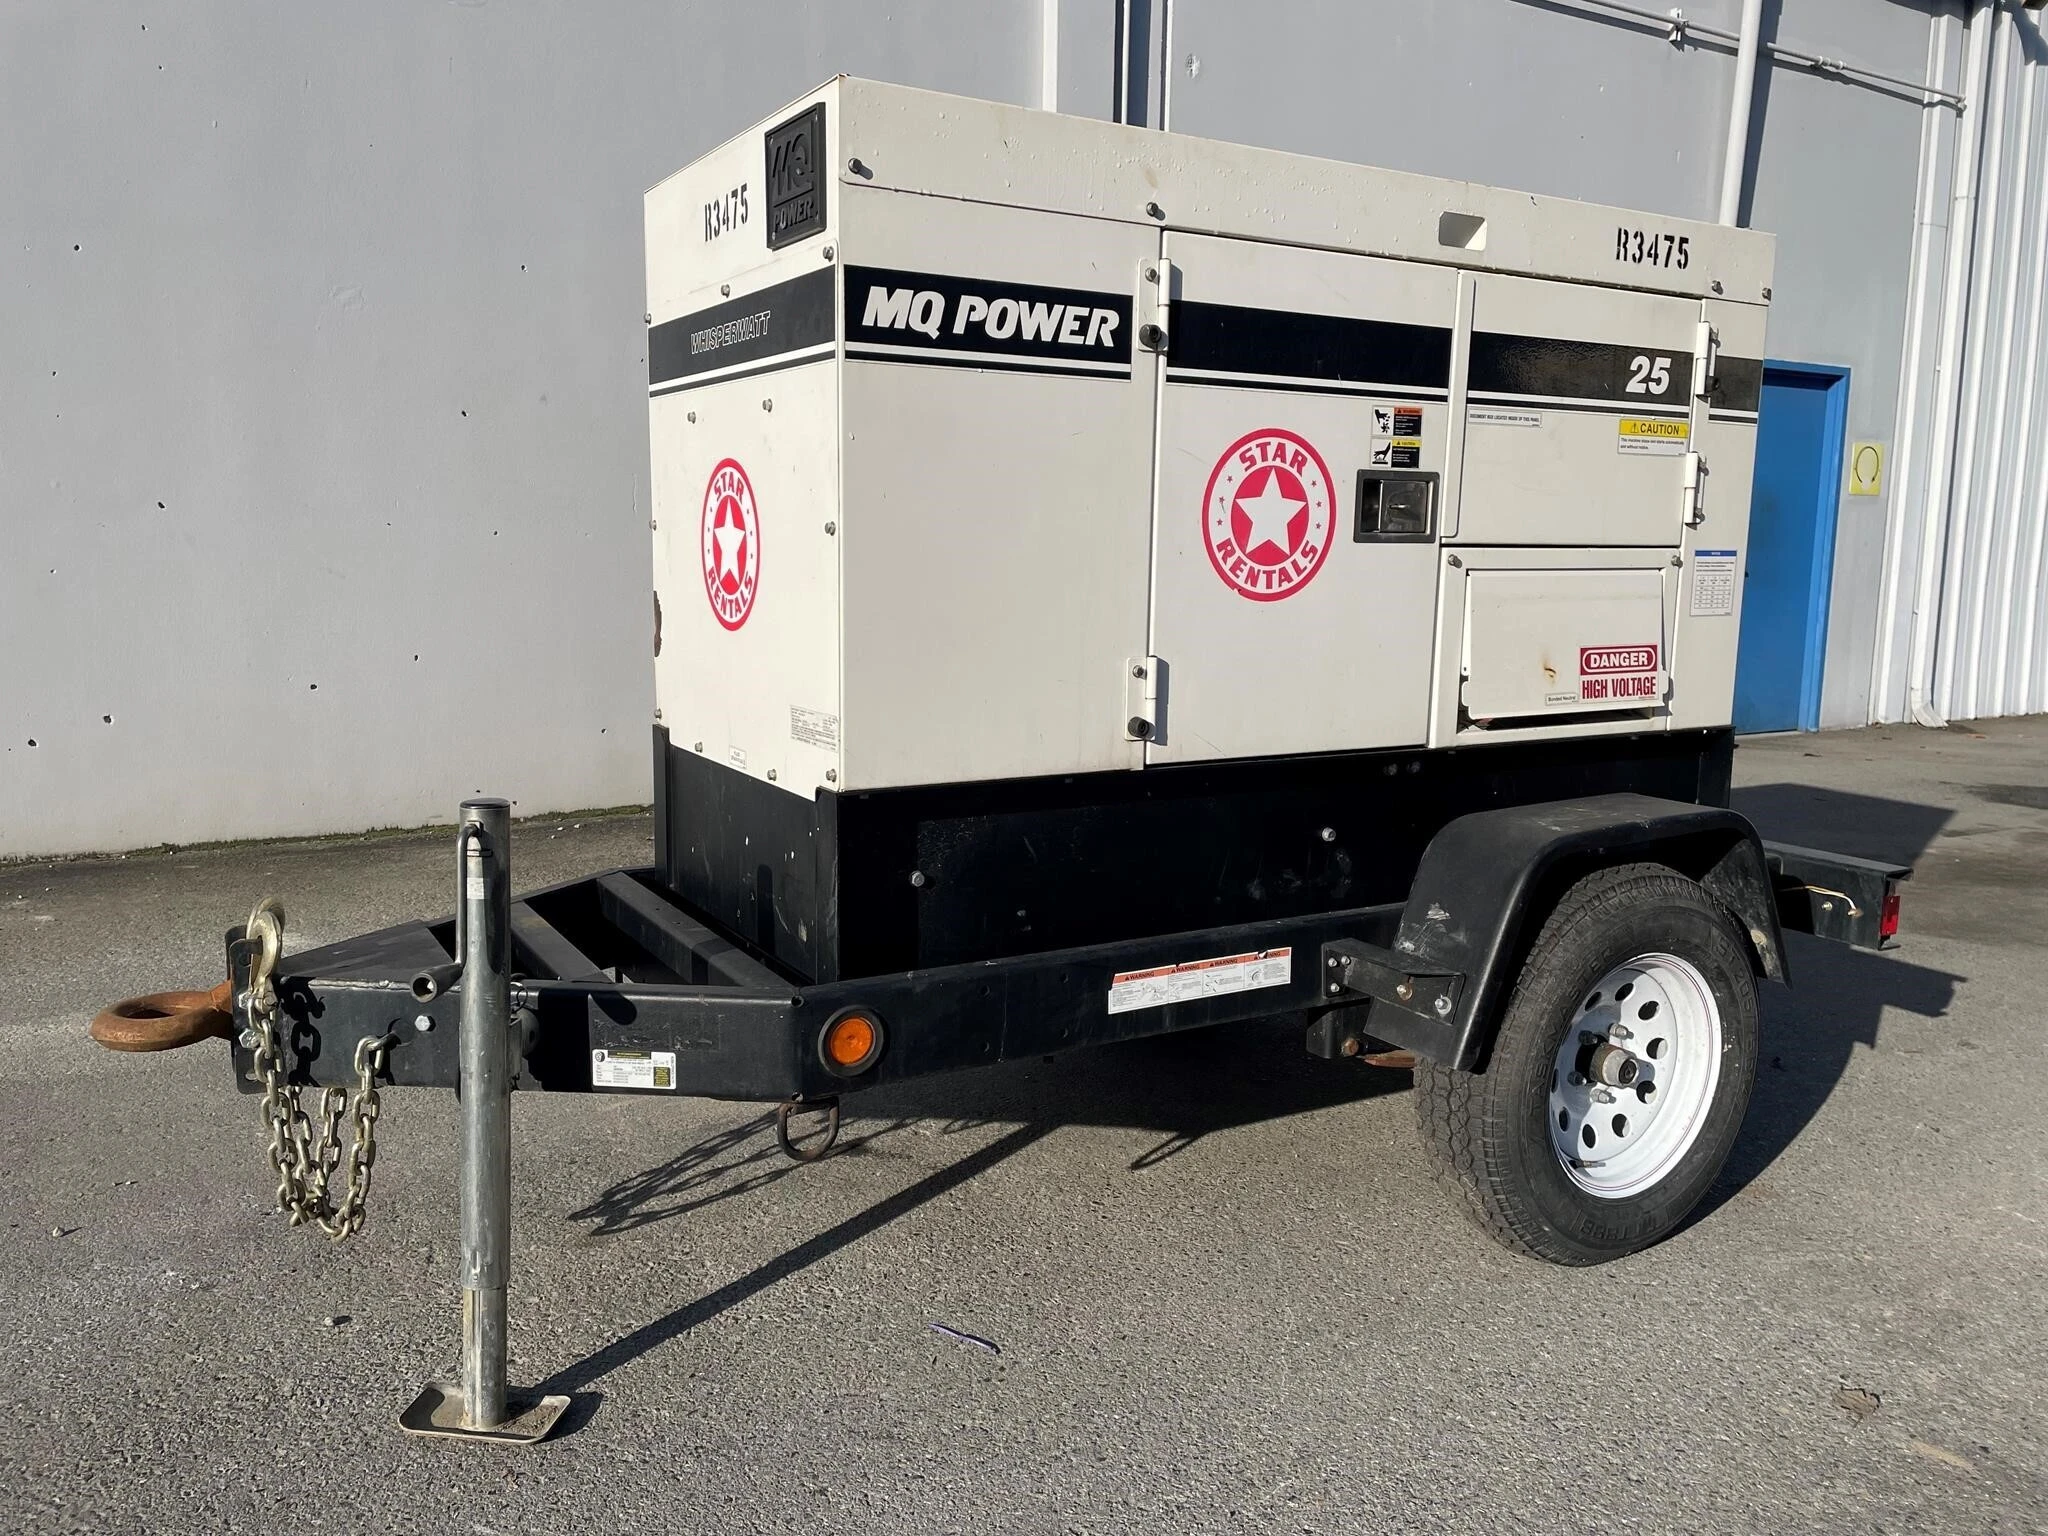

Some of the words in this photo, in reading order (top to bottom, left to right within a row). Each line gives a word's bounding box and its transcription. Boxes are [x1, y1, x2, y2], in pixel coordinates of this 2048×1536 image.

[705, 182, 748, 242] R3475
[774, 199, 814, 234] POWER
[1616, 227, 1690, 270] R3475
[690, 310, 771, 355] WHISPERWATT
[861, 285, 946, 340] MQ
[952, 294, 1120, 347] POWER
[1625, 355, 1672, 395] 25
[1640, 422, 1680, 435] CAUTION
[1238, 441, 1309, 478] STAR
[713, 471, 745, 505] STAR
[1216, 537, 1319, 590] RENTALS
[707, 566, 753, 619] RENTALS
[1590, 651, 1648, 668] DANGER
[1581, 678, 1608, 700] HIGH
[1611, 676, 1656, 698] VOLTAGE
[1130, 971, 1155, 981] WARNING
[1176, 964, 1200, 974] WARNING
[1214, 958, 1238, 967] WARNING
